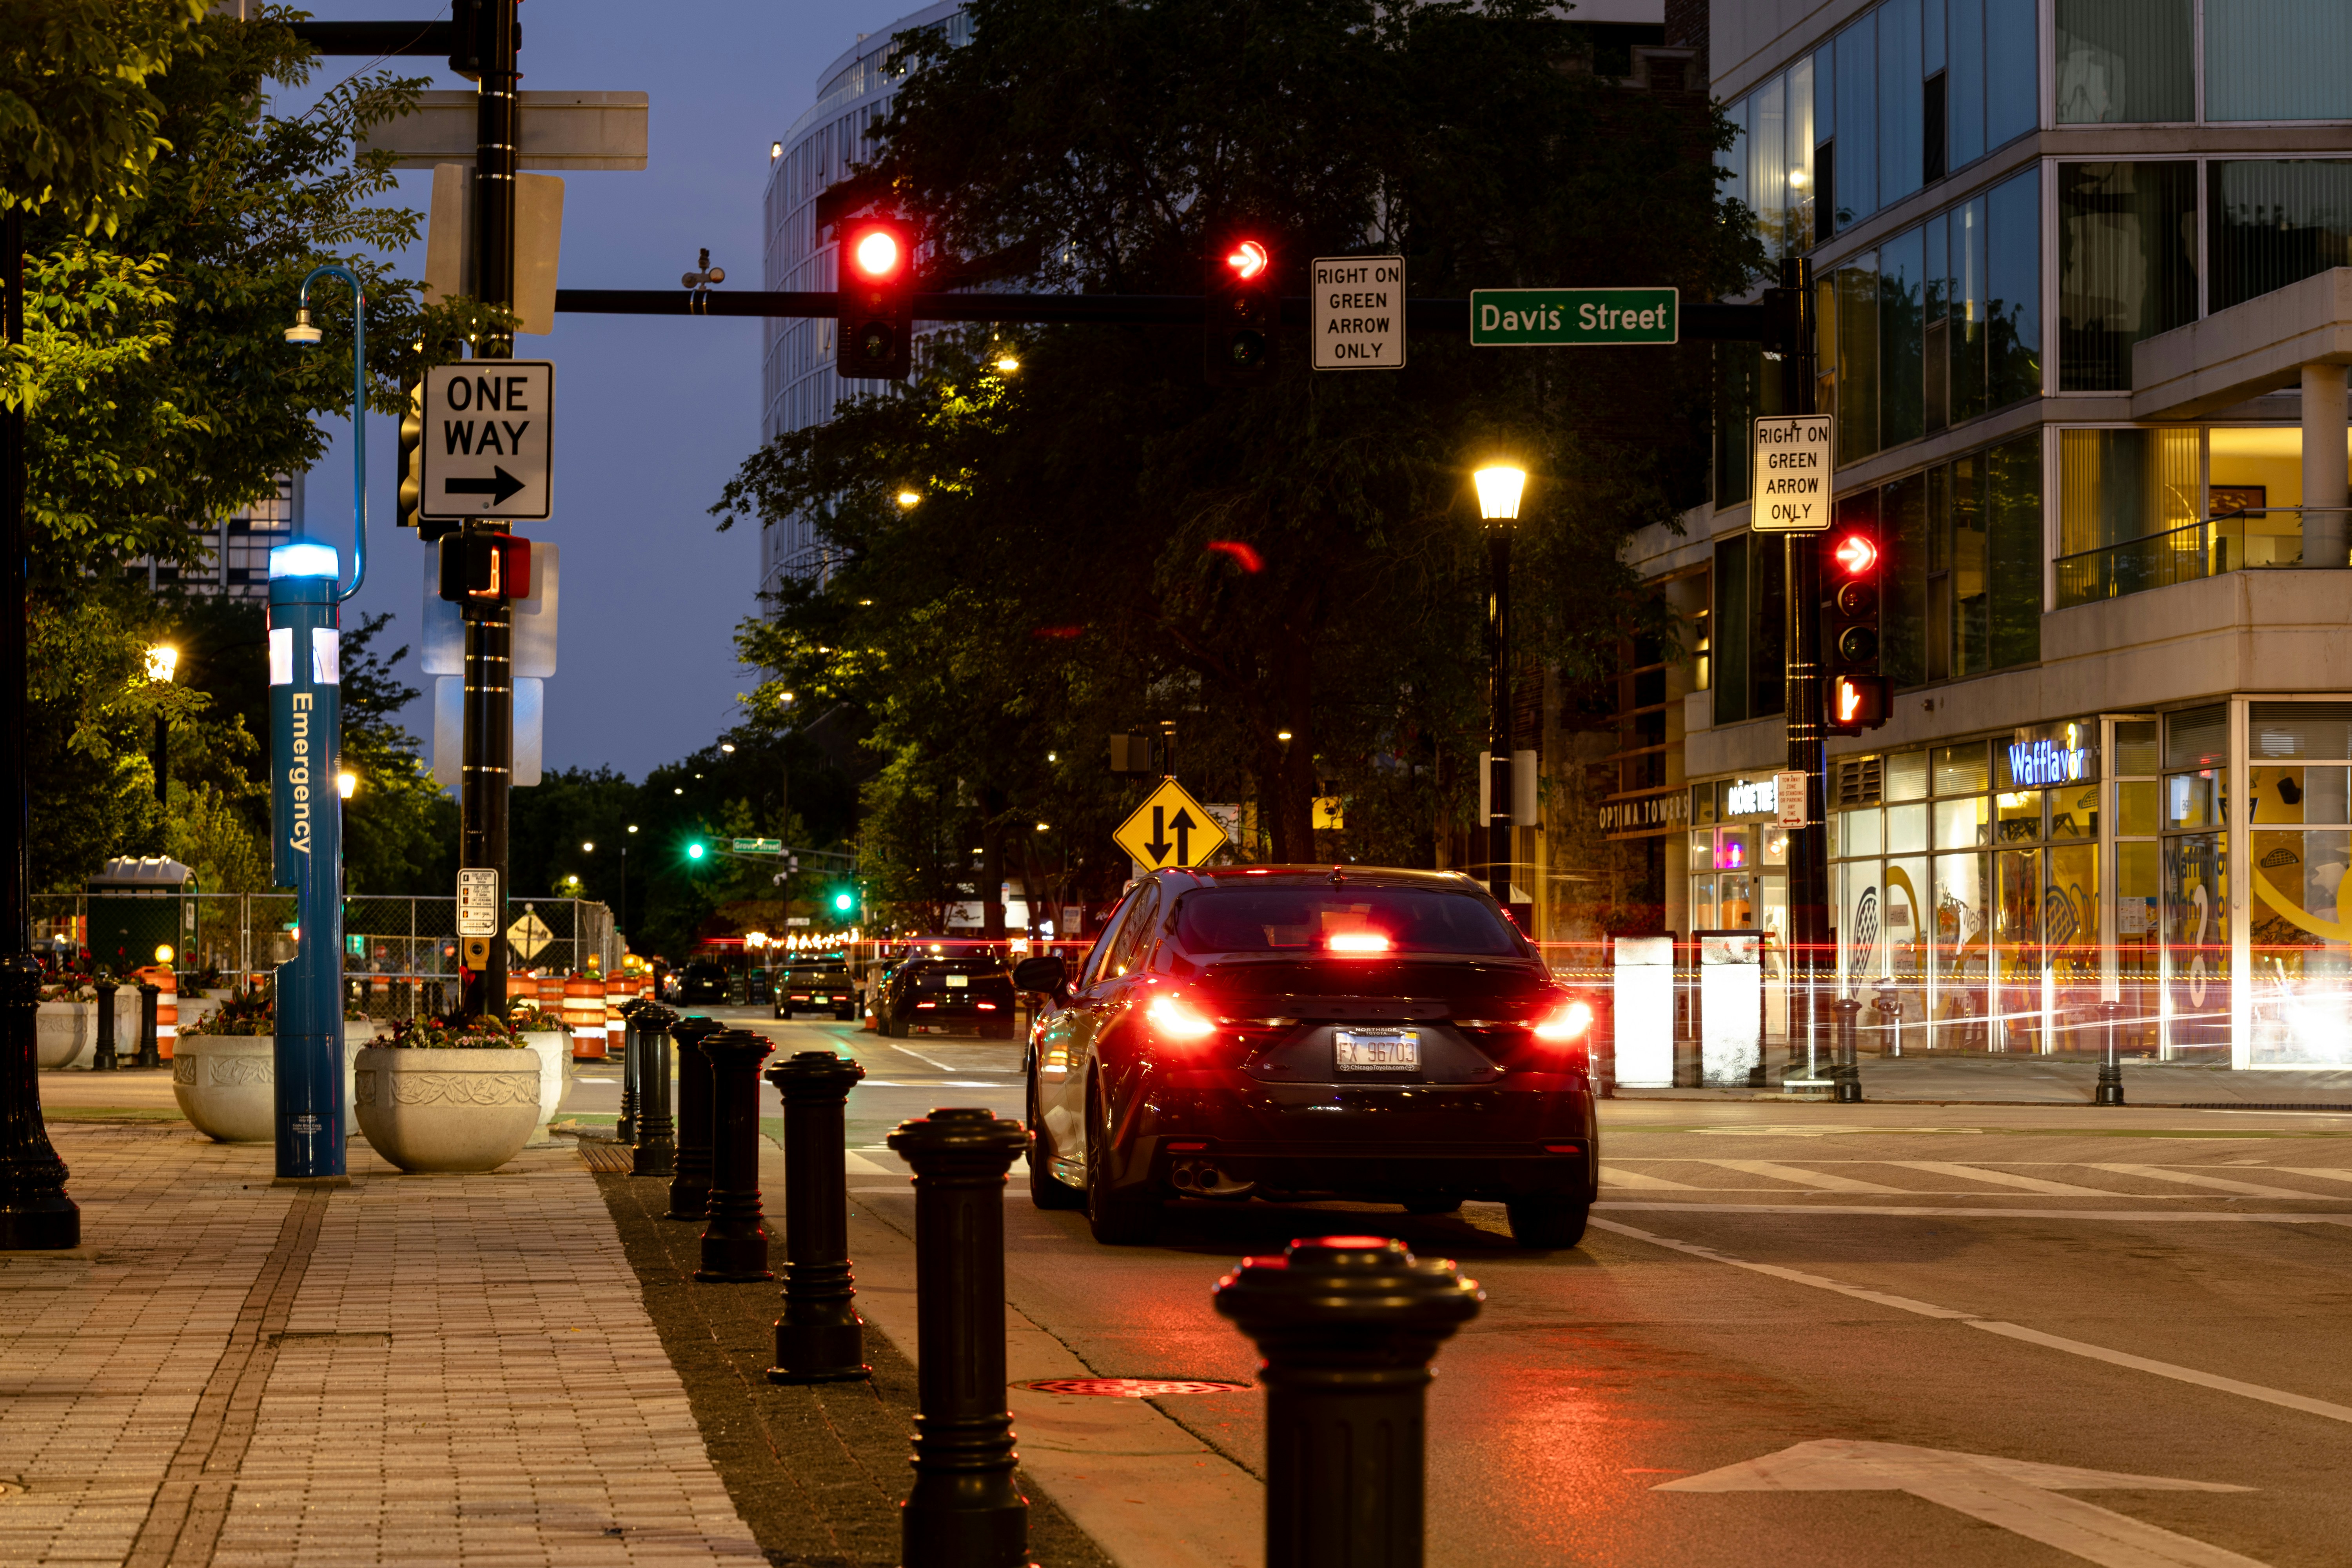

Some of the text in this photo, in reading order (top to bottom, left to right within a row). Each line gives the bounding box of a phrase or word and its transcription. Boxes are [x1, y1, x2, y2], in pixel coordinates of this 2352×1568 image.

[1318, 266, 1399, 284] RIGHT ON
[1329, 292, 1387, 309] GREEN
[1481, 302, 1667, 332] Davis Street
[1327, 318, 1390, 334] ARROW
[1334, 342, 1383, 359] ONLY
[447, 376, 528, 411] ONE
[444, 420, 530, 456] WAY
[1759, 426, 1828, 443] RIGHT ON
[1769, 452, 1817, 468] GREEN
[1766, 478, 1818, 494] ARROW
[1771, 503, 1812, 519] ONLY
[2009, 737, 2085, 786] Wafflavor
[289, 693, 312, 854] Emergency
[1599, 795, 1688, 829] OPTIMA TOWERS
[759, 842, 780, 851] Street
[1339, 1042, 1414, 1062] FX 96703
